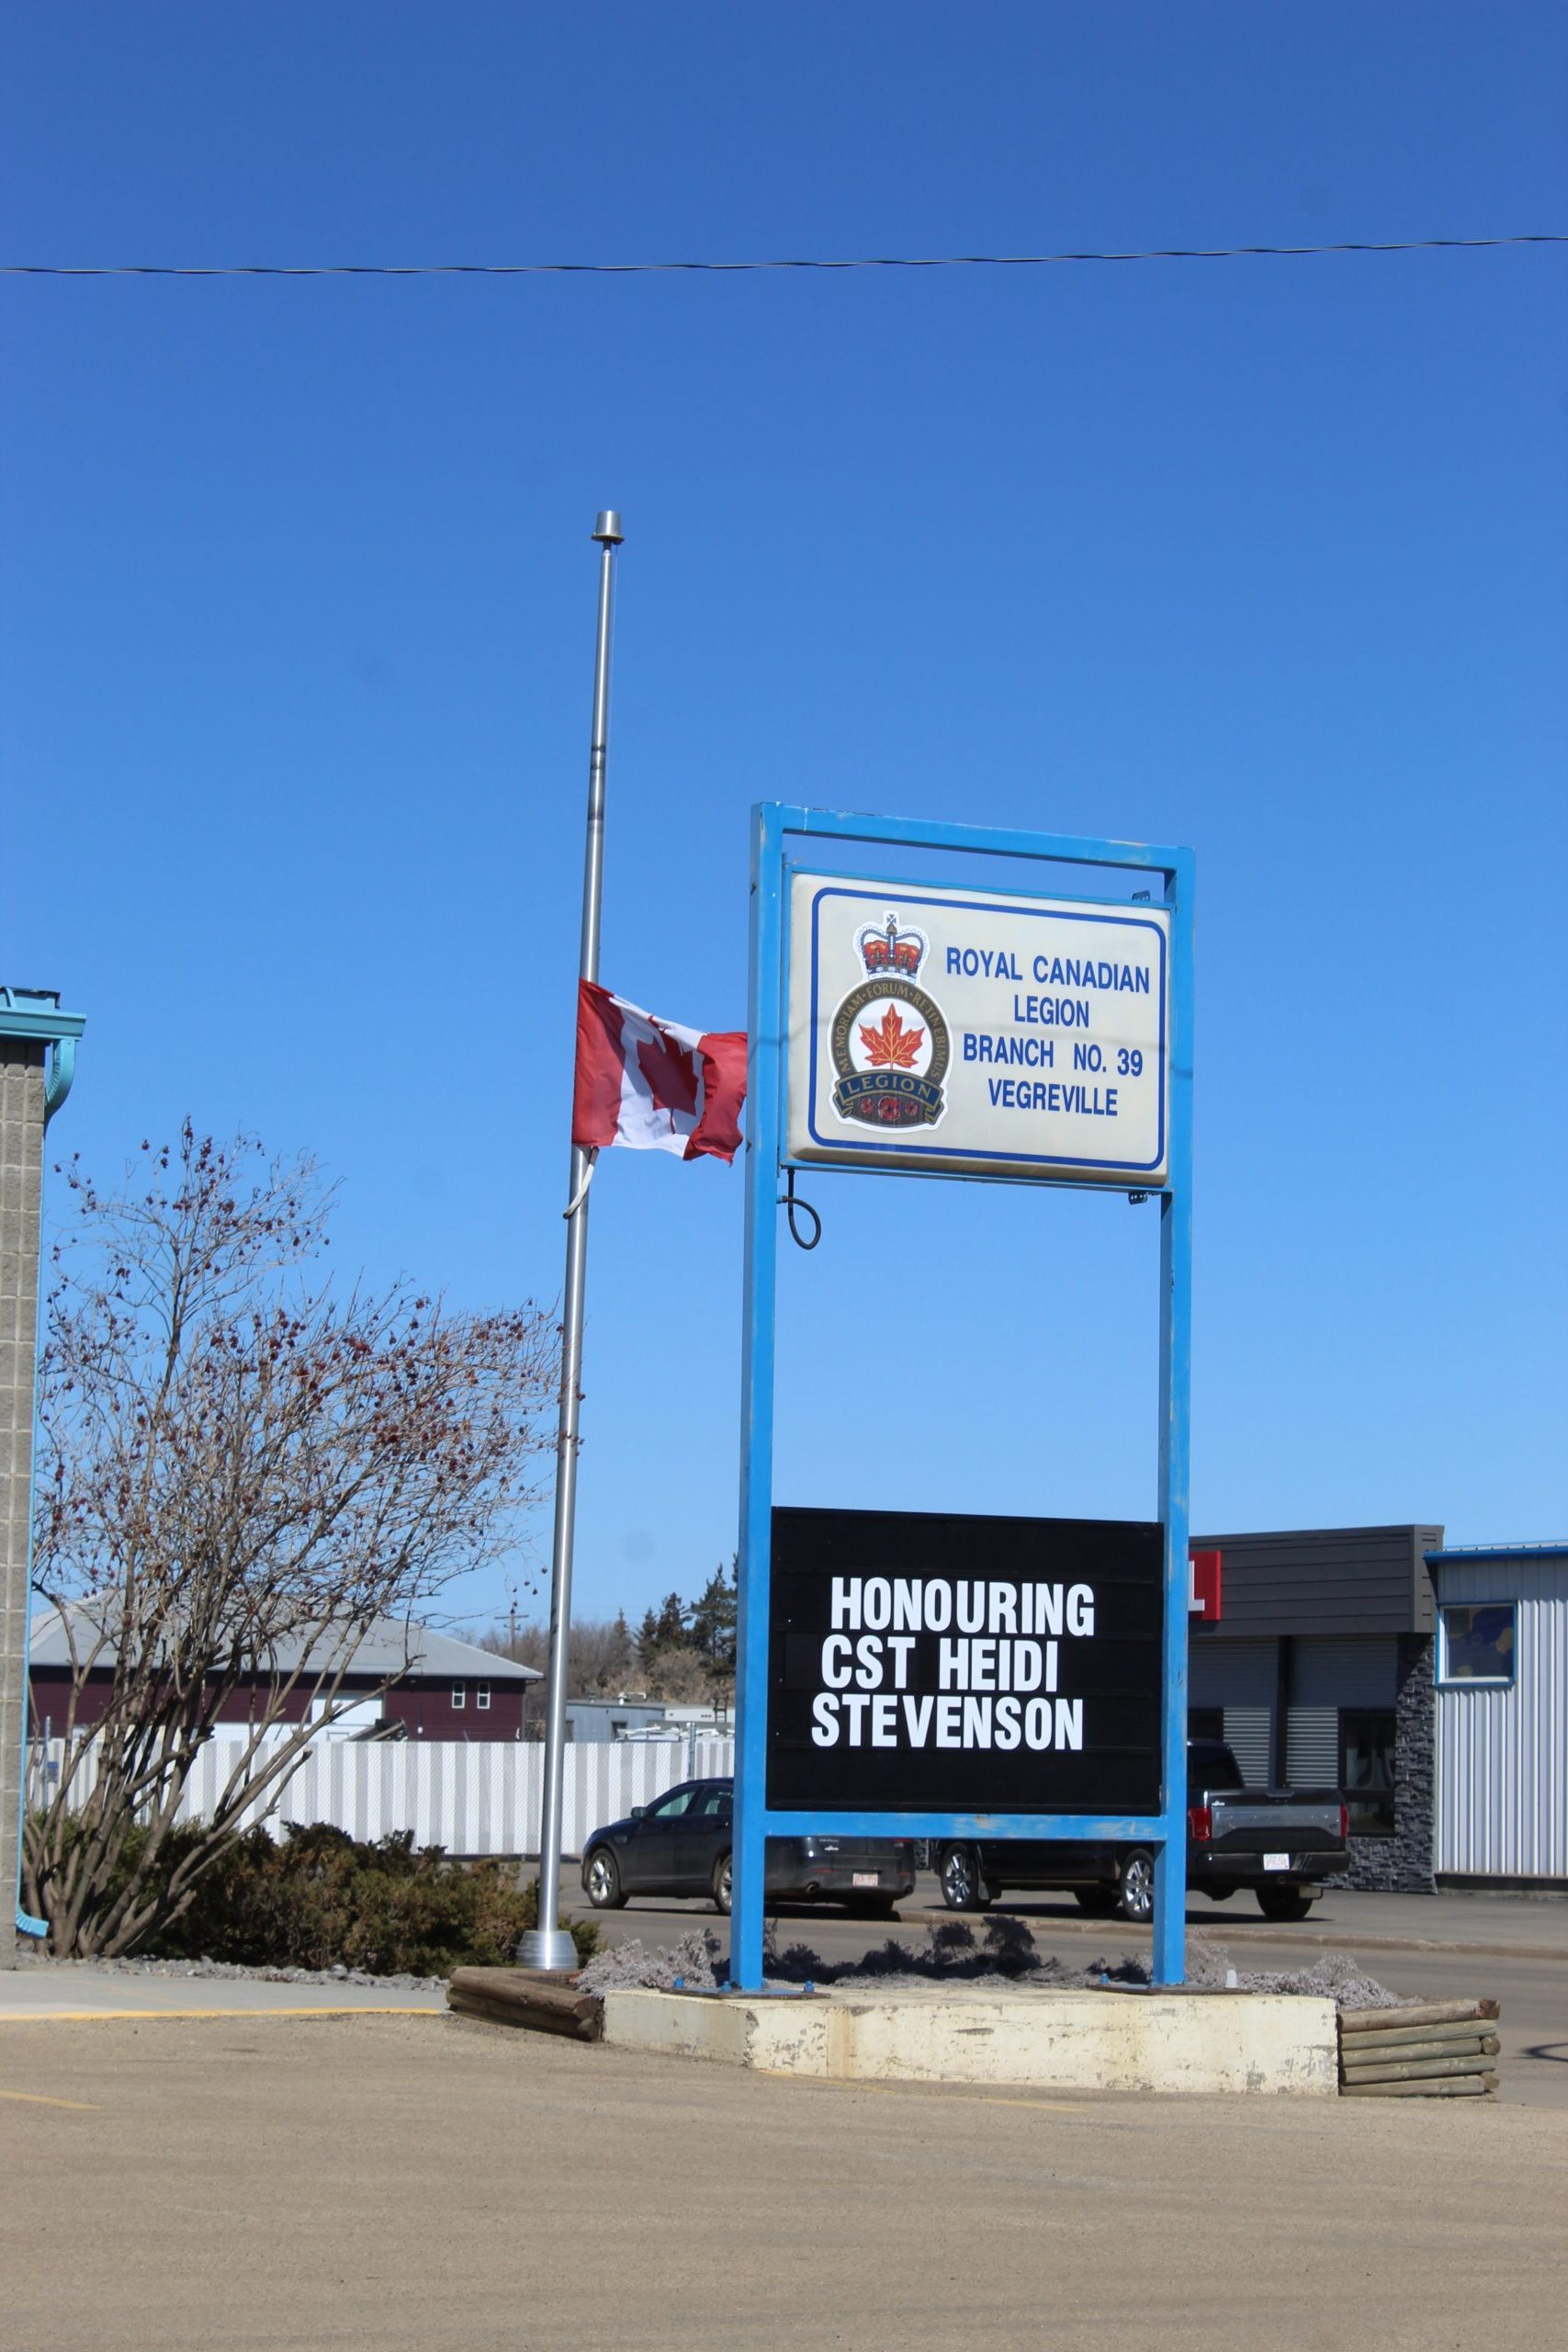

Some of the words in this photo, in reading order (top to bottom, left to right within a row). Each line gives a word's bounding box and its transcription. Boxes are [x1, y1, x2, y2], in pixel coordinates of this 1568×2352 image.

[946, 947, 1022, 980] ROYAL
[1032, 956, 1149, 994] CANADIAN
[1014, 995, 1089, 1028] LEGION
[835, 993, 865, 1072] MEMORIAM
[912, 993, 946, 1080] RETINEBIMUS
[964, 1034, 1054, 1068] BRANCH
[1074, 1045, 1107, 1073] NO.
[1117, 1048, 1143, 1077] 39
[847, 1075, 932, 1099] LEGION
[988, 1079, 1118, 1116] VEGREVILLE
[830, 1577, 1094, 1636] HONOURING
[821, 1634, 916, 1689] CST
[939, 1638, 1058, 1692] HEIDI
[811, 1692, 1083, 1750] STEVENSON
